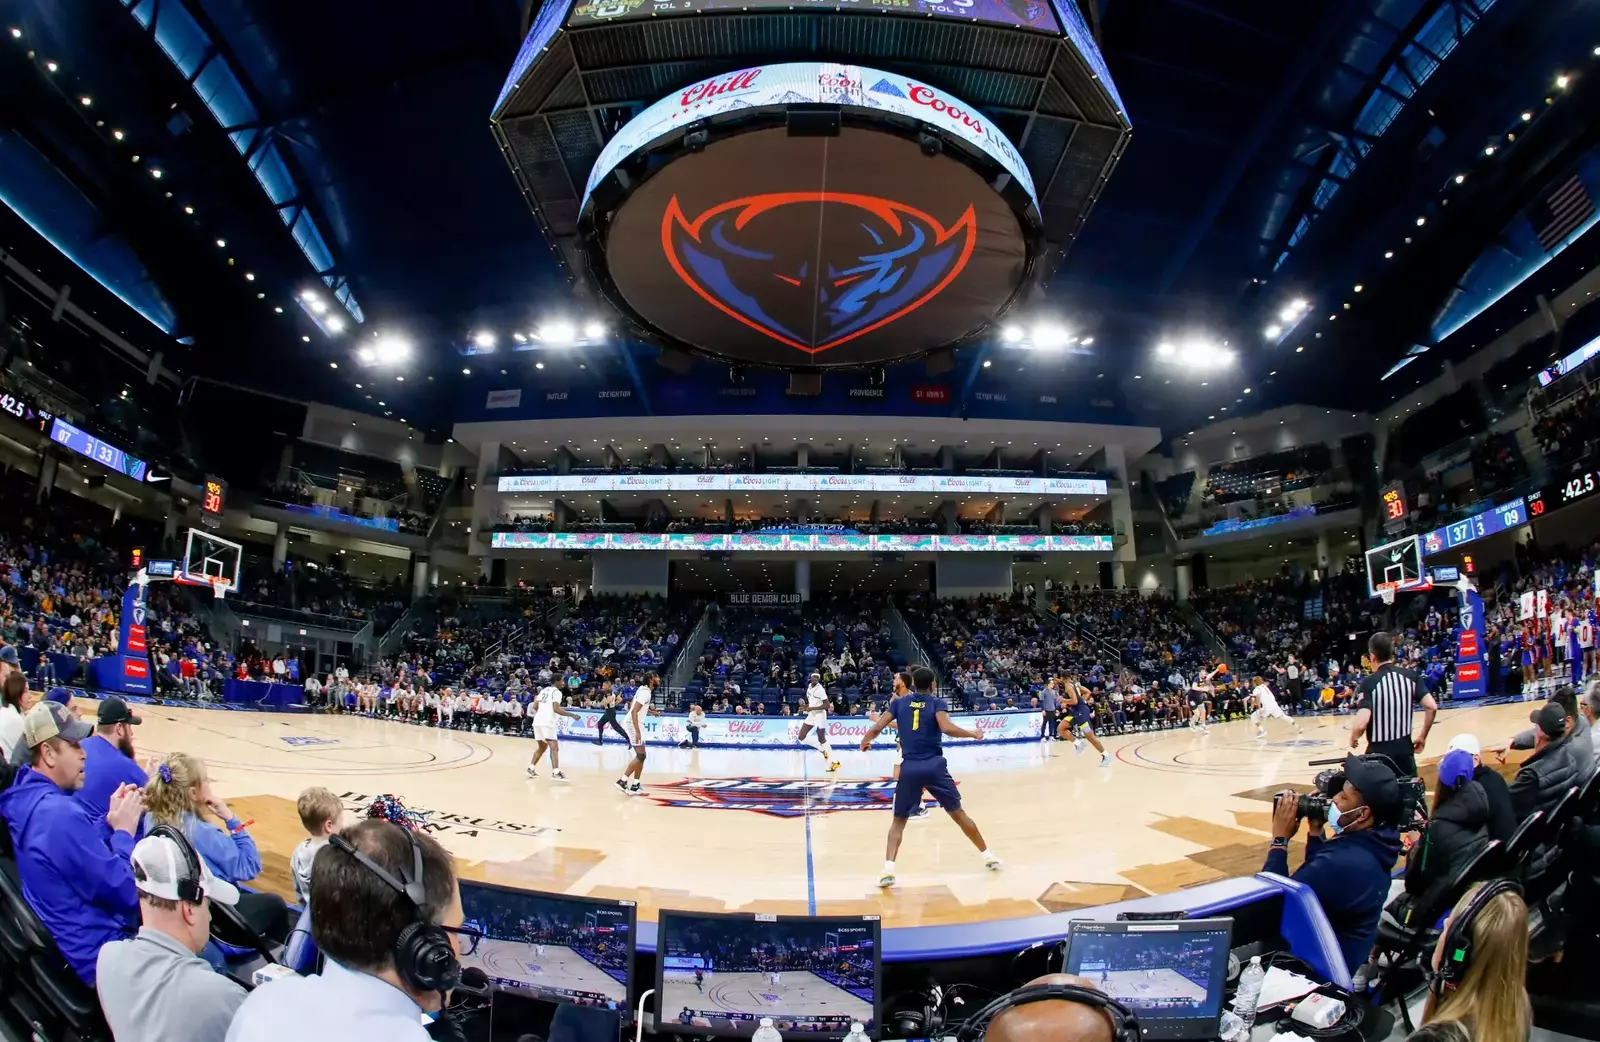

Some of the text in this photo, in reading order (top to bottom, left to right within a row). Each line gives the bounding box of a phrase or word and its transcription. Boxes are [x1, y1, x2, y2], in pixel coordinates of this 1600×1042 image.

[929, 4, 967, 15] TOL 3
[681, 69, 763, 107] Chill
[822, 86, 860, 97] LIGHT
[906, 82, 1027, 179] Coors LIGHT
[546, 392, 569, 402] BUTLER
[598, 390, 632, 399] CREIGHTON
[849, 388, 884, 397] PROVIDENCE
[0, 393, 25, 418] 42.5
[38, 409, 53, 421] HALF
[39, 420, 46, 432] 1
[58, 429, 72, 444] 07
[84, 442, 113, 462] 3 33
[696, 475, 715, 483] Chill
[742, 475, 762, 485] Coors
[898, 476, 916, 484] Chill
[1561, 472, 1595, 502] :42.5
[203, 493, 221, 512] 30
[1527, 491, 1541, 502] SHOT
[1387, 499, 1403, 520] 30
[1529, 500, 1545, 516] 30
[1453, 523, 1468, 542] 37
[1476, 521, 1485, 536] 3
[1503, 509, 1519, 527] 09
[730, 593, 801, 604] BLUE DEMON CLUB
[908, 700, 926, 709] JONES
[911, 708, 920, 731] 1
[974, 716, 1009, 730] Chill
[728, 720, 765, 734] Chill
[829, 721, 869, 737] Coors
[680, 780, 898, 790] DEPAU
